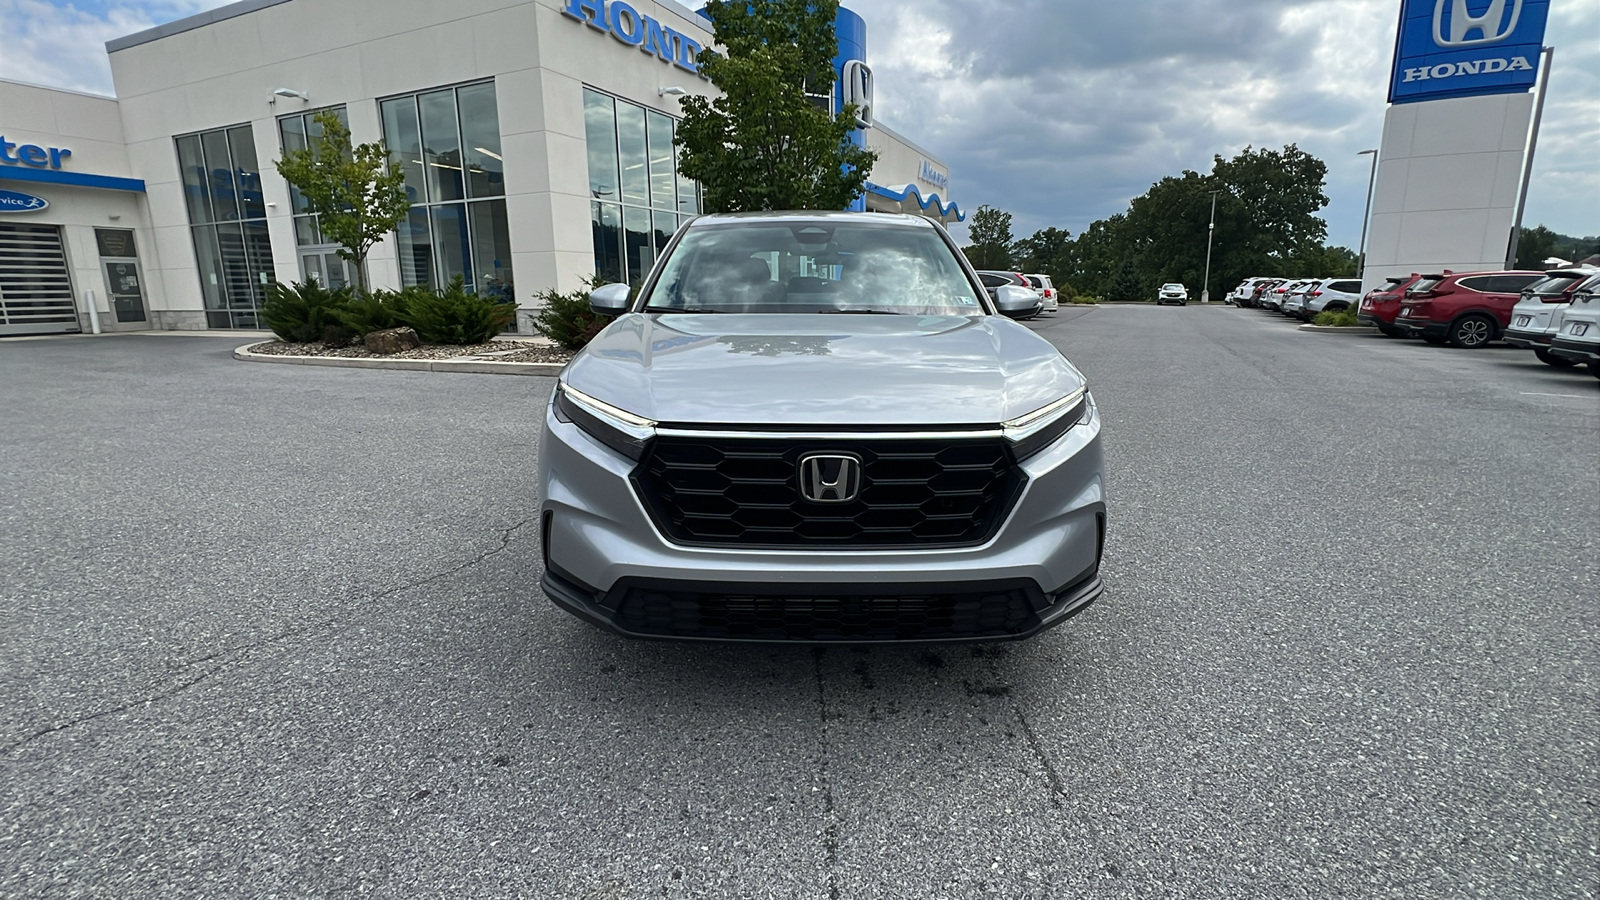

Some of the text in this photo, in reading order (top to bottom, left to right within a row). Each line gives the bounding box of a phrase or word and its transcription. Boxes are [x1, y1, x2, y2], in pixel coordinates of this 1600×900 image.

[561, 0, 717, 80] HOND
[1402, 56, 1533, 83] HONDA
[0, 197, 24, 205] vice
